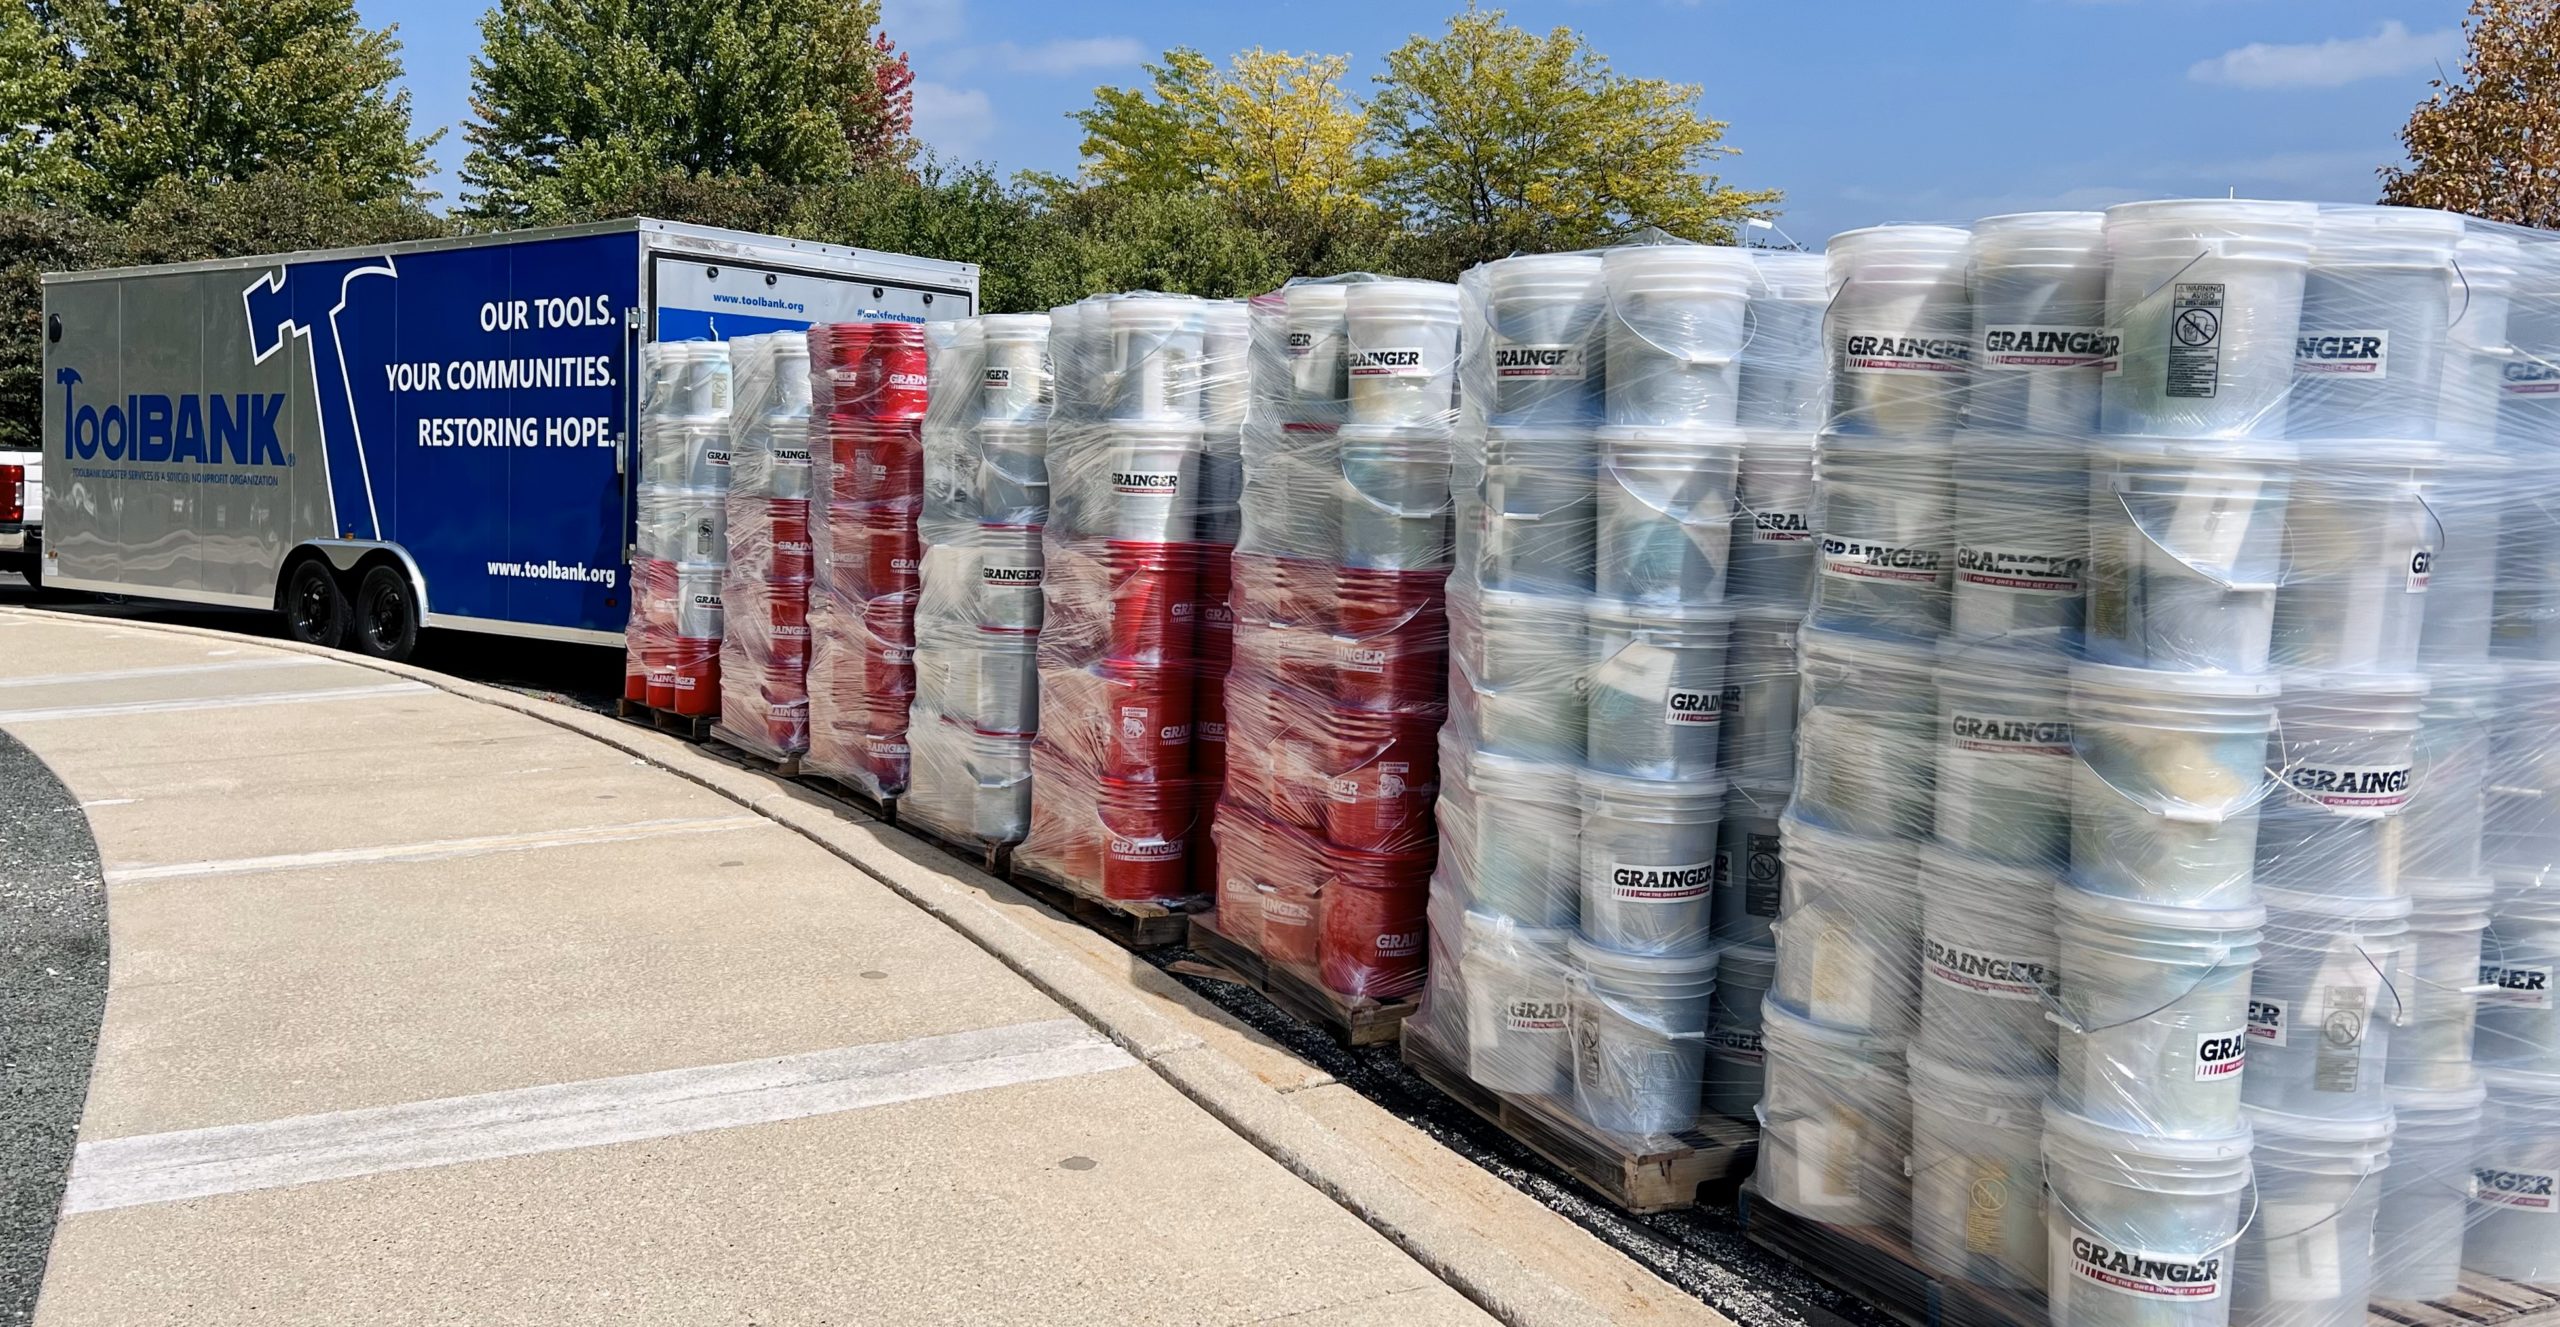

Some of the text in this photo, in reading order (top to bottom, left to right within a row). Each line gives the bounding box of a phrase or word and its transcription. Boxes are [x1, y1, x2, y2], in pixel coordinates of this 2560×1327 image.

[480, 295, 616, 331] OUR TOOLS.
[713, 293, 804, 312] www.toolbank.org
[1848, 336, 1969, 360] GRAINGER
[1986, 331, 2119, 357] GRAINGER
[2296, 337, 2381, 359] NGER
[1350, 352, 1419, 367] RAINGER
[385, 356, 616, 391] YOUR COMMUNITIES.
[418, 416, 616, 447] RESTORING HOPE.
[192, 473, 228, 484] NONPROFIT
[230, 474, 279, 486] ORGANIZATION
[1112, 473, 1178, 486] GRAINGER
[487, 560, 615, 588] www.toolbank.org
[984, 568, 1042, 580] GRAINGER
[1958, 548, 2082, 578] GRAINGER
[1953, 715, 2074, 742] GRAINGE
[2292, 767, 2411, 793] GRAINGE
[1111, 840, 1184, 855] GRAINGER
[1614, 865, 1712, 888] GRAINGER
[2073, 1237, 2219, 1282] GRAINGER
[2101, 1274, 2117, 1284] FOR
[2118, 1279, 2132, 1288] THE
[2133, 1282, 2155, 1292] ONES
